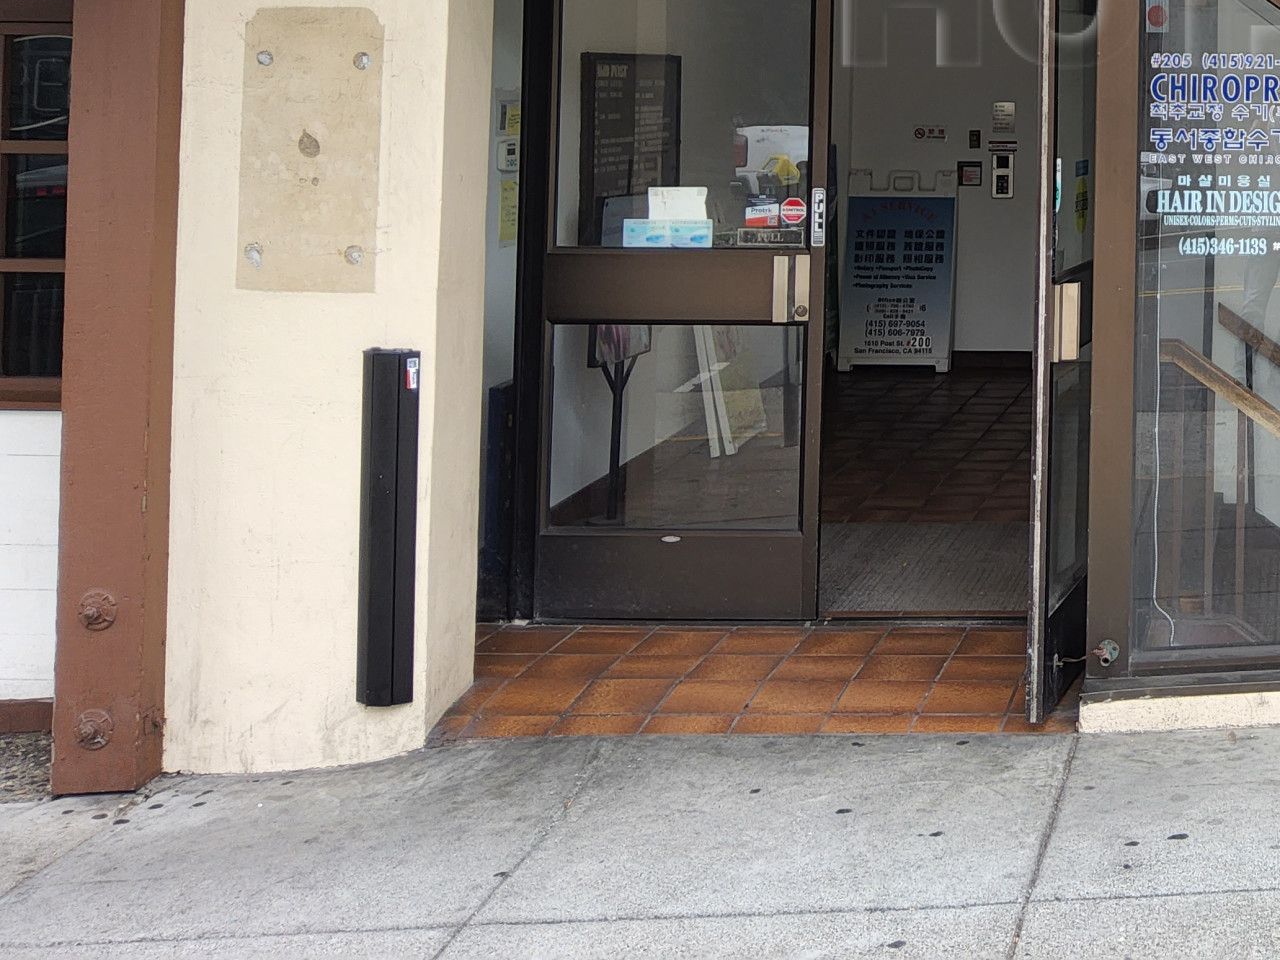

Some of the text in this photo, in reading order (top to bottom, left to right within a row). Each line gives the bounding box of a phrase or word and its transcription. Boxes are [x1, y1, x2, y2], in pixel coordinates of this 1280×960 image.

[1151, 52, 1192, 68] #205
[1150, 103, 1224, 121] 척추교정
[1149, 153, 1187, 164] EAST
[1192, 153, 1232, 165] WEST
[1157, 190, 1203, 213] HAIR
[1206, 190, 1226, 213] IN
[814, 193, 824, 232] PULL
